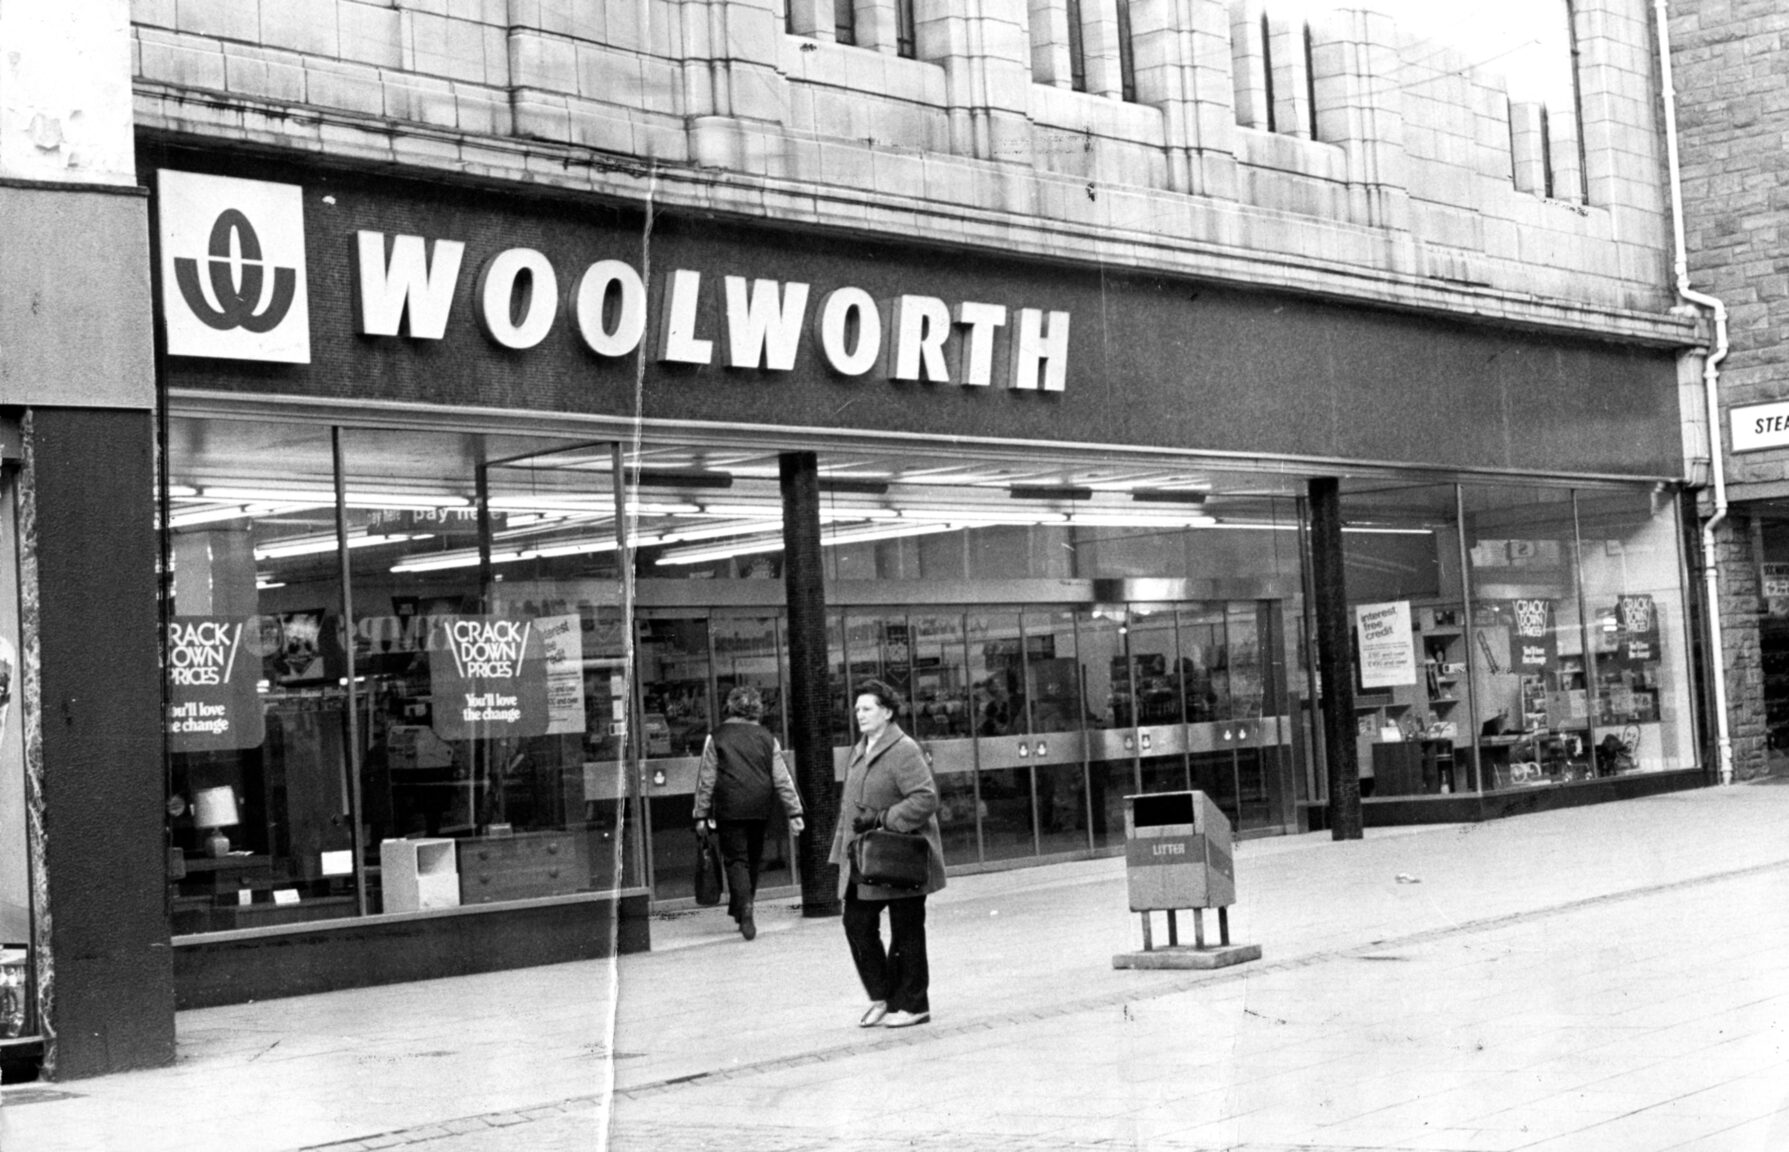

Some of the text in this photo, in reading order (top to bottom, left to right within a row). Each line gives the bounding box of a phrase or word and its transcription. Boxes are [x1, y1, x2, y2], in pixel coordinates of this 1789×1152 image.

[351, 230, 1070, 391] WOOLWORTH
[1361, 606, 1397, 623] interest
[168, 622, 231, 646] RACK
[453, 620, 522, 643] CRACK
[1363, 620, 1383, 632] free
[1365, 626, 1394, 640] credit
[171, 645, 225, 667] OWN
[461, 641, 517, 662] DOWN
[467, 660, 513, 678] PRICES
[198, 701, 226, 716] love
[464, 693, 518, 707] You'll love
[463, 706, 521, 722] the change
[182, 717, 229, 734] change
[1153, 843, 1186, 856] LITTER
